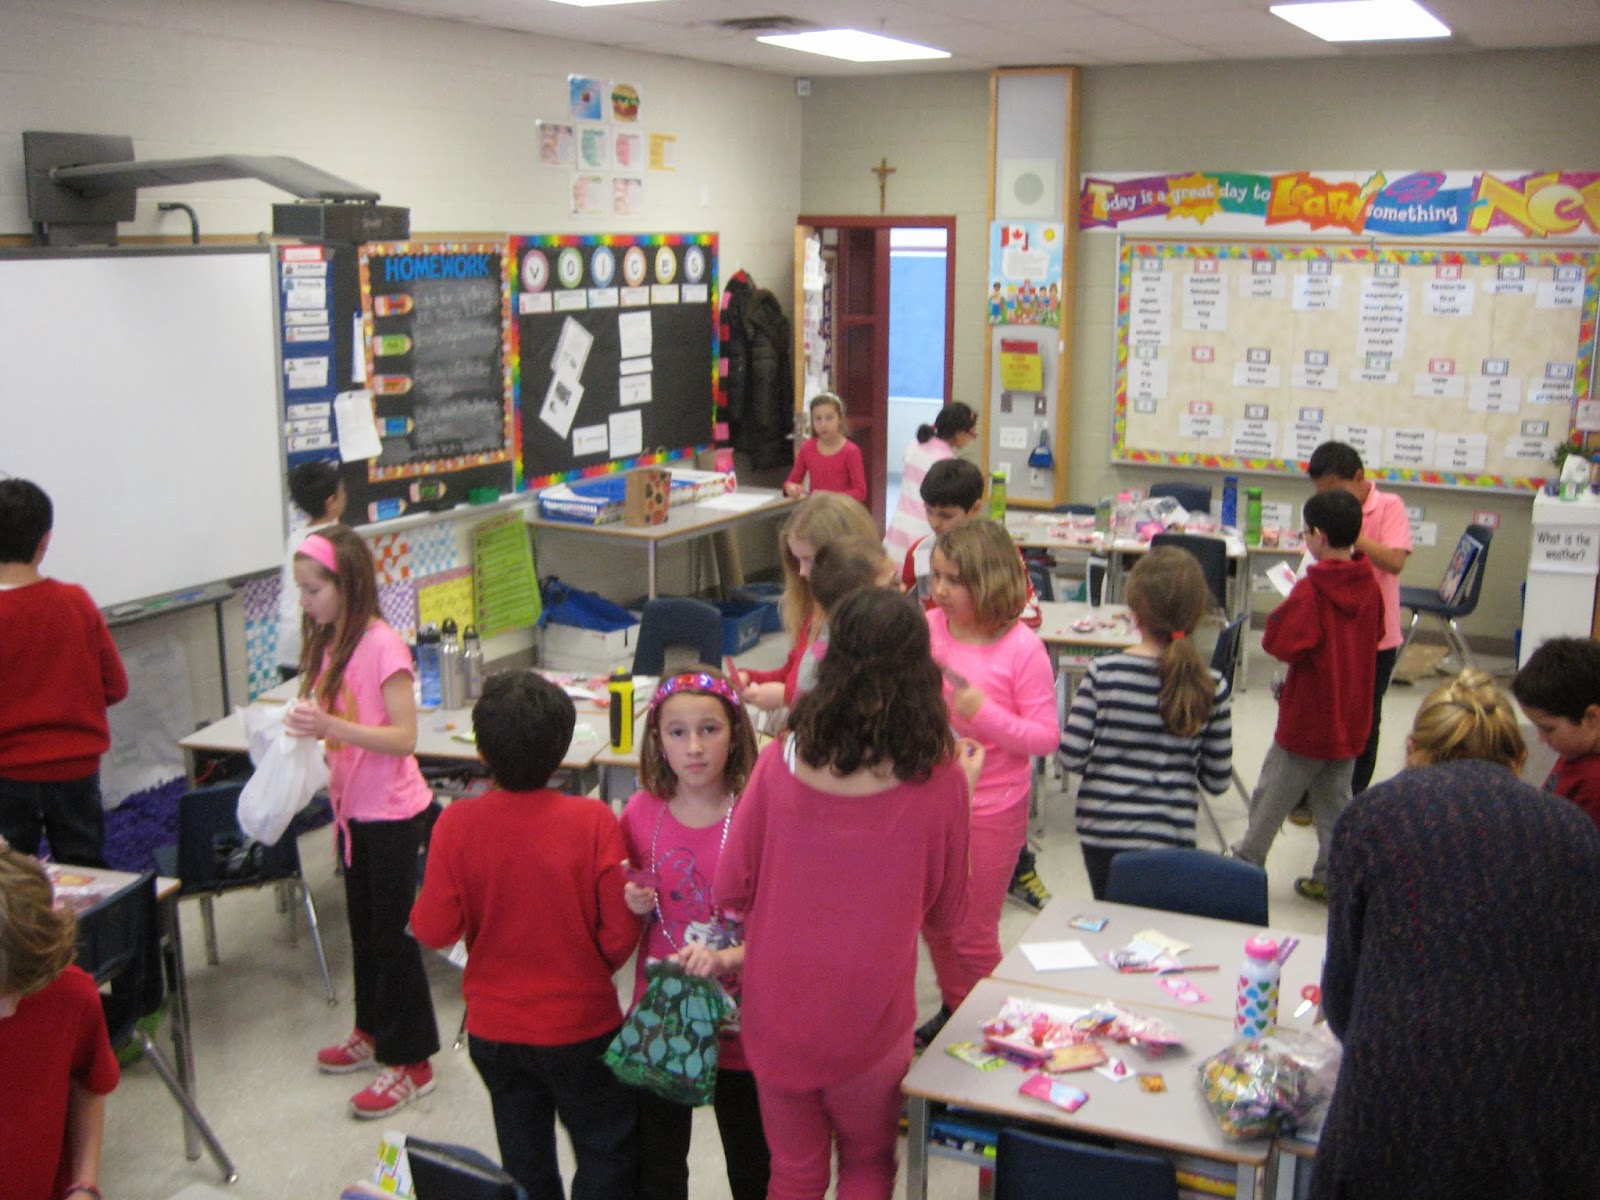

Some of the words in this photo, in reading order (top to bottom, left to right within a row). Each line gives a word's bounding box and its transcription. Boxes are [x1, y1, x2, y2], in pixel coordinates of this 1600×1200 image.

[1087, 182, 1137, 221] Today
[1142, 188, 1155, 204] is
[1158, 190, 1168, 203] a
[1170, 183, 1216, 206] great
[1220, 181, 1248, 203] day
[1254, 183, 1272, 202] to
[1366, 204, 1459, 224] something
[384, 254, 490, 282] HOMEWORK
[1537, 531, 1561, 544] What
[1565, 532, 1573, 545] is
[1576, 532, 1591, 546] the
[1546, 549, 1586, 561] weather?
